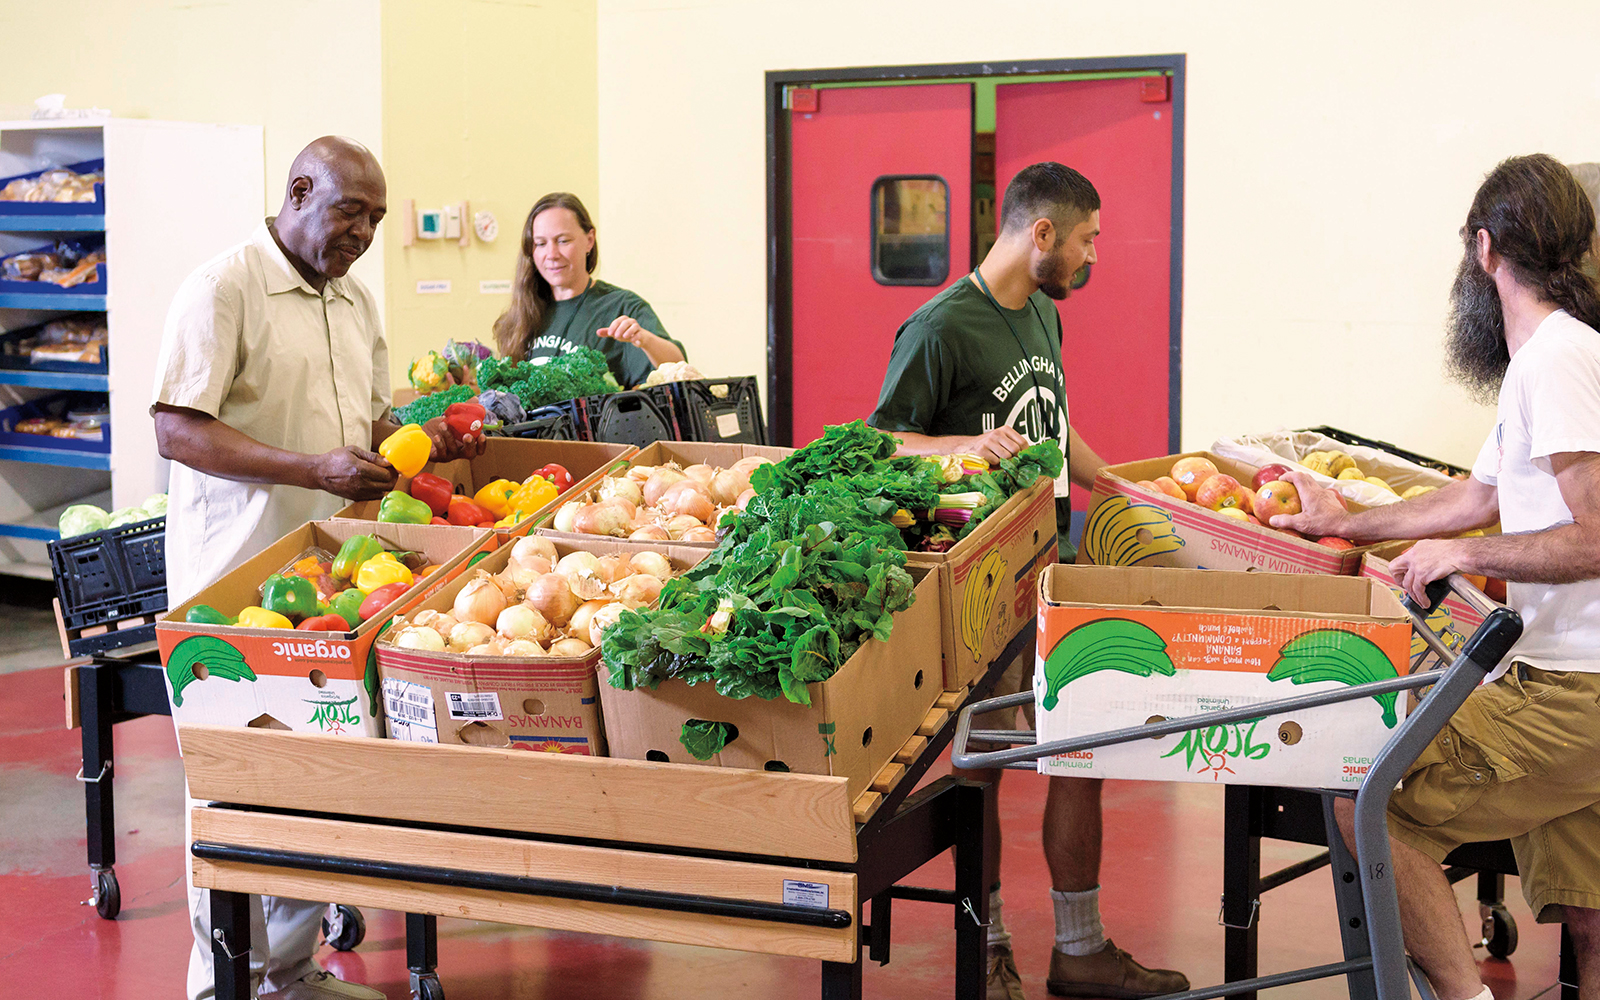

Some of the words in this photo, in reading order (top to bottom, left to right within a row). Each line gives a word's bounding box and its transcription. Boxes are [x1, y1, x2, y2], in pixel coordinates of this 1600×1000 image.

[1210, 538, 1266, 567] BANANAS
[1198, 624, 1221, 634] bunch
[1172, 633, 1232, 644] COMMUNITY?
[272, 640, 351, 661] organic
[1206, 645, 1242, 655] BANANA
[1223, 655, 1243, 664] many
[1245, 658, 1261, 666] How
[1196, 697, 1230, 705] Unlimited
[508, 714, 583, 728] BANANAS
[1049, 760, 1093, 769] premium
[1342, 756, 1374, 764] nanas
[1342, 765, 1371, 776] anic
[1369, 862, 1385, 880] 18
